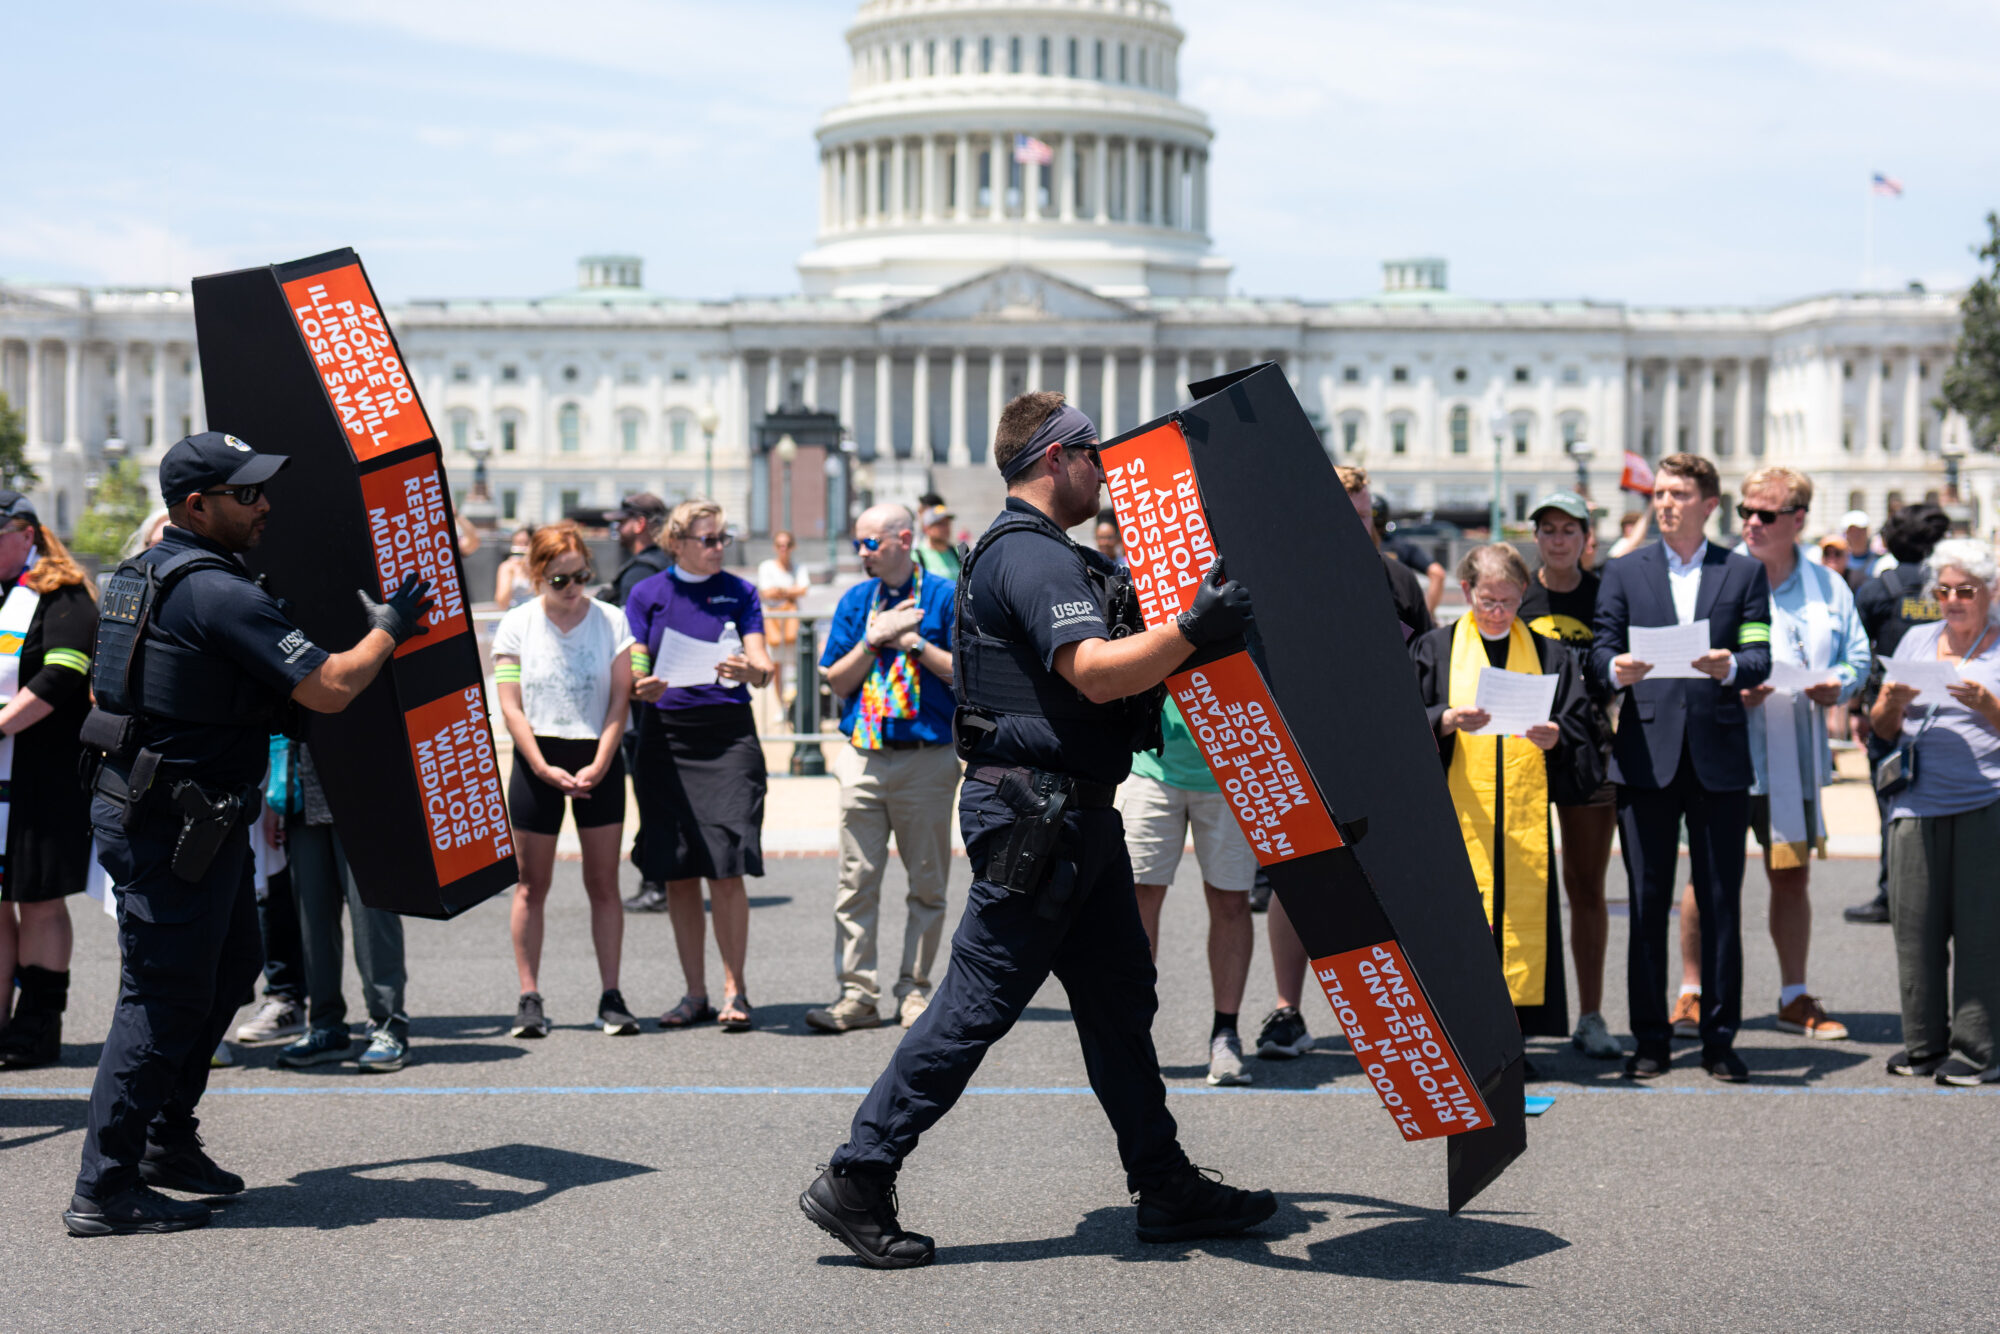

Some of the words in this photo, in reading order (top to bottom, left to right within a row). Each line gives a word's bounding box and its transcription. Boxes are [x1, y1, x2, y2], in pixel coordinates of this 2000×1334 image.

[295, 305, 335, 367] LOSE
[324, 371, 364, 435] SNAP
[307, 284, 363, 384] ILLINOIS
[354, 386, 389, 447] WILL
[335, 299, 387, 388] PEOPLE
[375, 391, 400, 419] IN
[359, 303, 413, 404] 472,000
[422, 469, 446, 526] THIS
[1106, 466, 1145, 568] COFFIN
[1173, 469, 1218, 582] URDER!
[369, 507, 400, 600] MURDE
[433, 530, 464, 618] COFFIN
[1154, 487, 1198, 588] POLICY
[1051, 601, 1094, 619] USCP
[451, 719, 470, 746] IN
[1178, 688, 1230, 769] PEOPLE
[1191, 671, 1241, 750] ISLAND
[1226, 701, 1265, 758] LOSE
[434, 726, 458, 786] WILL
[464, 687, 494, 775] 514,000
[482, 777, 512, 859] PEOPLE
[1232, 753, 1280, 828] RHODE
[1247, 701, 1310, 806] MEDICAID
[1259, 761, 1293, 816] WILL
[416, 739, 452, 851] MEDICAID
[445, 787, 472, 848] LOSE
[457, 748, 489, 841] ILLINOIS
[1225, 778, 1273, 854] 45,000
[1271, 832, 1295, 857] IN
[1318, 968, 1373, 1053] PEOPLE
[1358, 960, 1412, 1044] ISLAND
[1372, 946, 1415, 1007] SNAP
[1375, 1038, 1401, 1064] IN
[1406, 1013, 1450, 1071] LOSE
[1368, 1063, 1423, 1136] 21,000
[1402, 1047, 1458, 1123] RHODE
[1442, 1074, 1482, 1129] WILL
